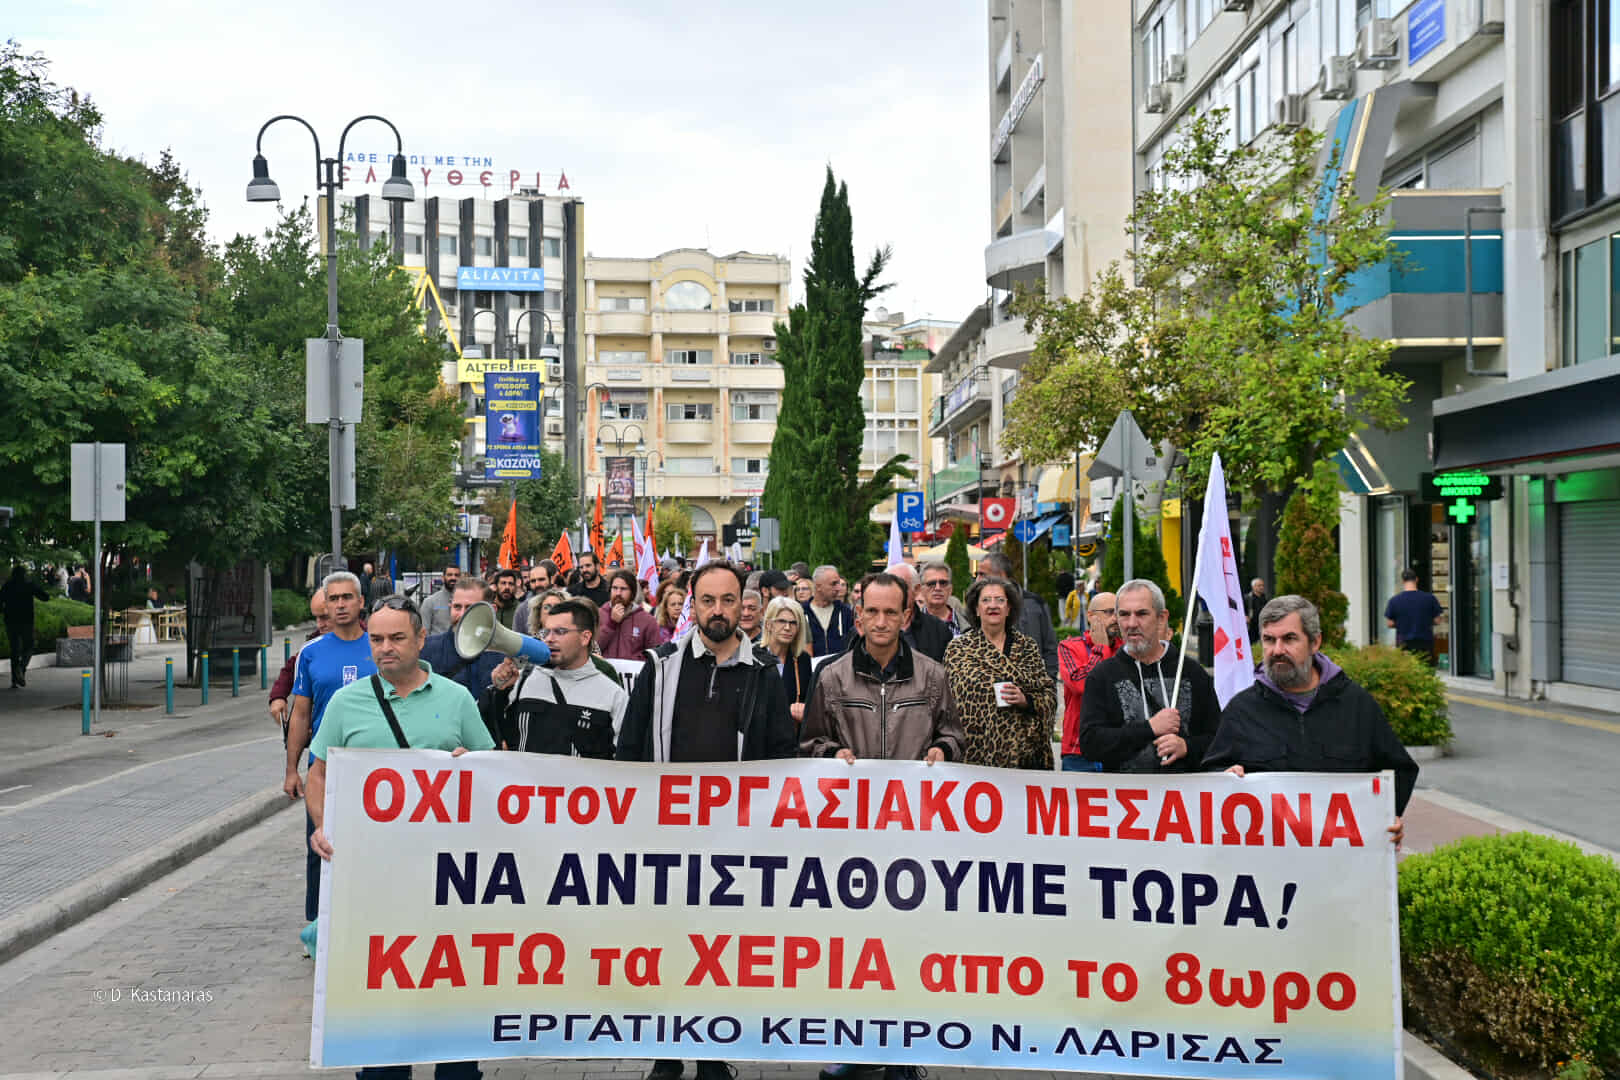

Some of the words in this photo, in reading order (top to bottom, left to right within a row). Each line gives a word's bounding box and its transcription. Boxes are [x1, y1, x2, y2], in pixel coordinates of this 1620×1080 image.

[338, 153, 377, 163] ΑΘΕ
[387, 154, 426, 165] ΠΩΙ
[435, 155, 456, 166] ΜΕ
[463, 156, 493, 167] ΤΗΝ
[341, 165, 571, 190] ΕΛΥΘΕΡΙΑ
[460, 270, 541, 281] ALIAVITA
[902, 495, 920, 513] P
[362, 767, 473, 824] ΟΧΙ
[497, 784, 638, 825] στον
[658, 774, 1004, 834] ΕΡΓΑΣΙΑΚΟ
[1025, 784, 1365, 848] ΜΕΣΑΙΩΝΑ
[434, 851, 526, 906] ΝΑ
[546, 853, 1067, 917] ΑΝΤΙΣΤΑΘΟΥΜΕ
[1089, 866, 1298, 931] ΤΩΡΑ!
[366, 932, 567, 990] ΚΑΤΩ
[591, 946, 663, 987] τα
[684, 933, 897, 991] ΧΕΡΙΑ
[919, 951, 1045, 997] απο
[1067, 959, 1139, 1003] το
[1165, 952, 1357, 1024] 8ωρο
[493, 1014, 742, 1044] ΕΡΓΑΤΙΚΟ
[762, 1017, 972, 1050] ΚΕΝΤΡΟ
[992, 1023, 1040, 1053] Ν.
[1055, 1027, 1284, 1065] ΛΑΡΙΣΑΣ
